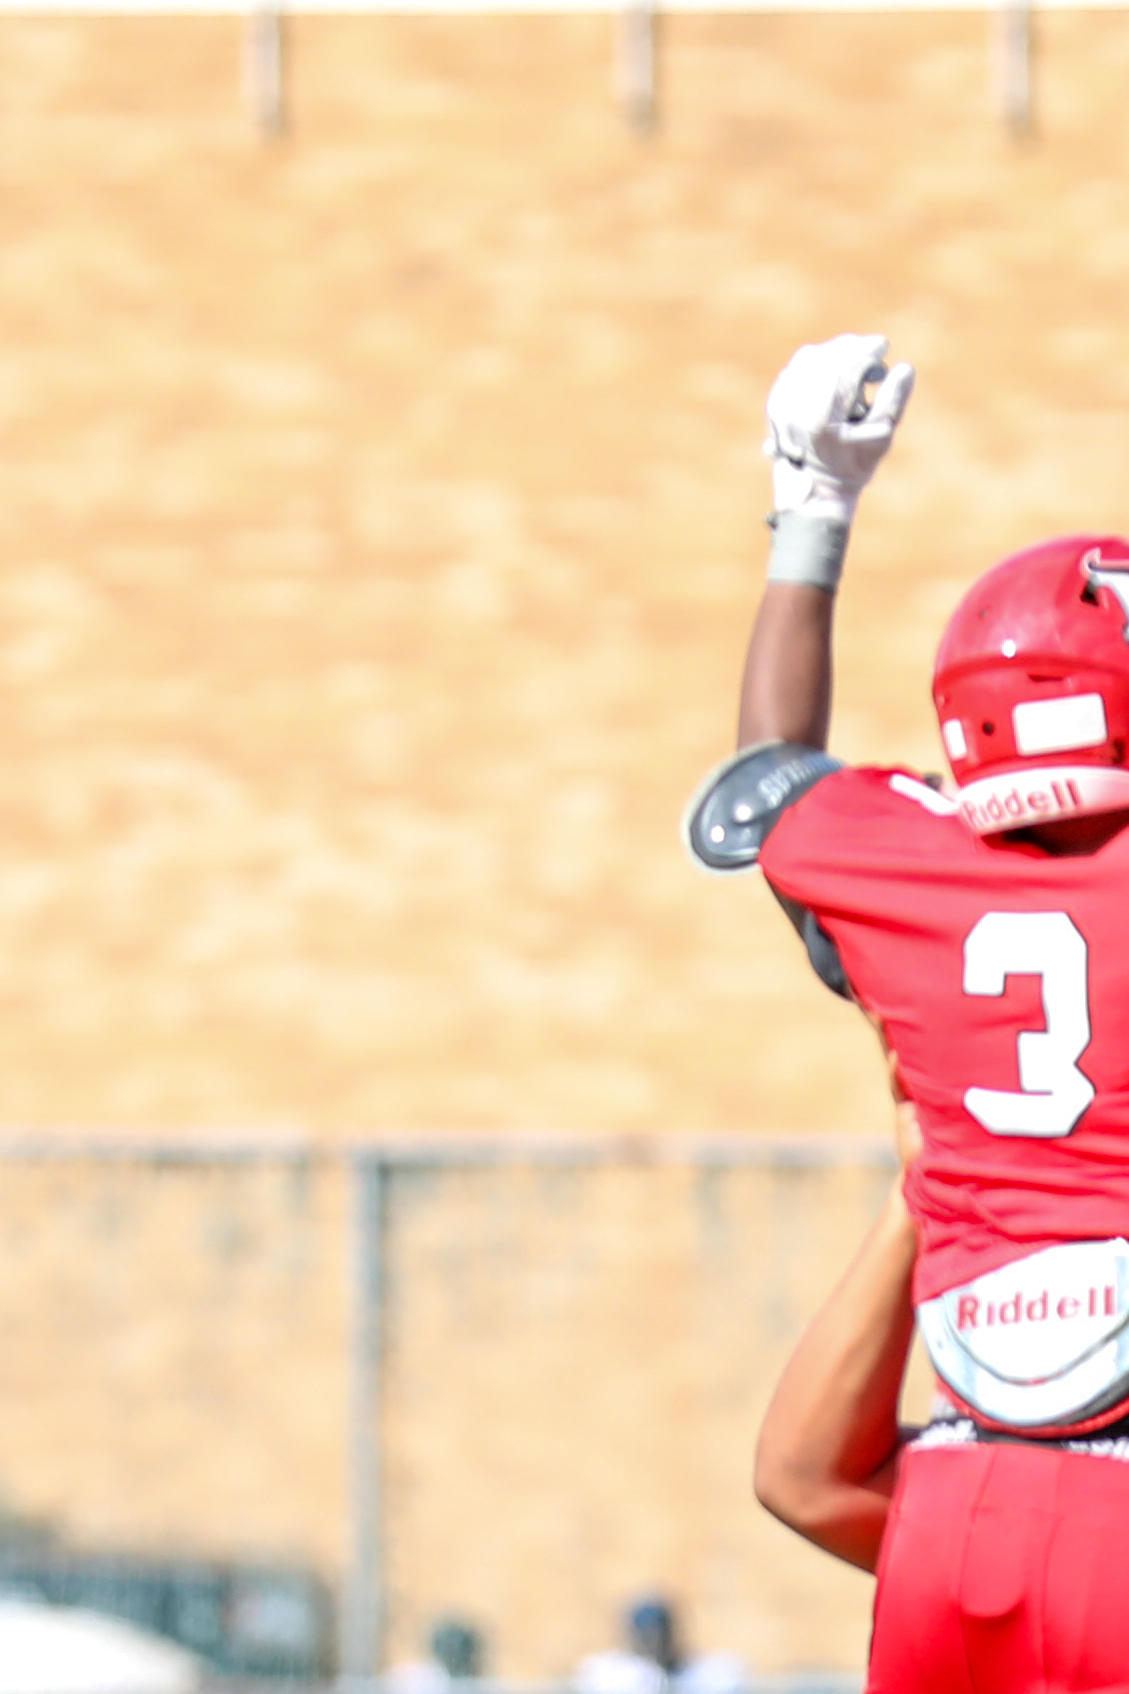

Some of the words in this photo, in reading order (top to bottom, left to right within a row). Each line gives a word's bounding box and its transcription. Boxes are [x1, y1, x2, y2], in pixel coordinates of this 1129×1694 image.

[961, 778, 1081, 829] Riddell
[961, 911, 1096, 1138] 3
[957, 1284, 1115, 1331] Riddell
